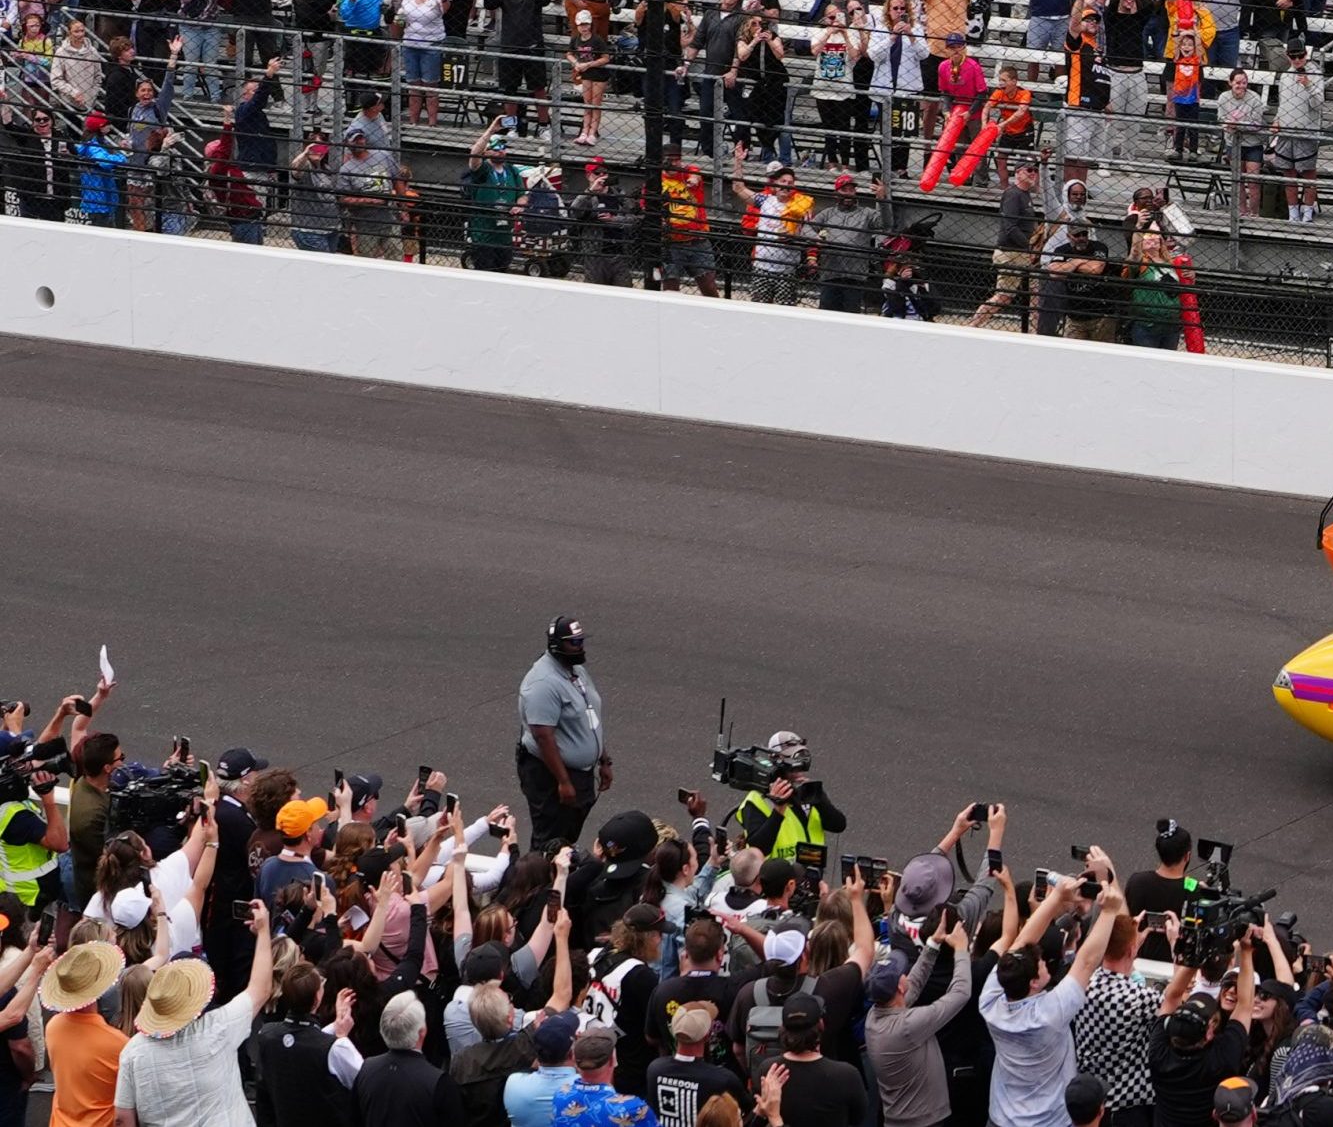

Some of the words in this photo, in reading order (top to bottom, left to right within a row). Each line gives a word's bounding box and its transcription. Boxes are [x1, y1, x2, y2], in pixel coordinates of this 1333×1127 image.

[443, 64, 451, 82] BOX
[452, 64, 466, 84] 17
[902, 111, 915, 131] 18
[657, 1076, 699, 1090] FREEDOM
